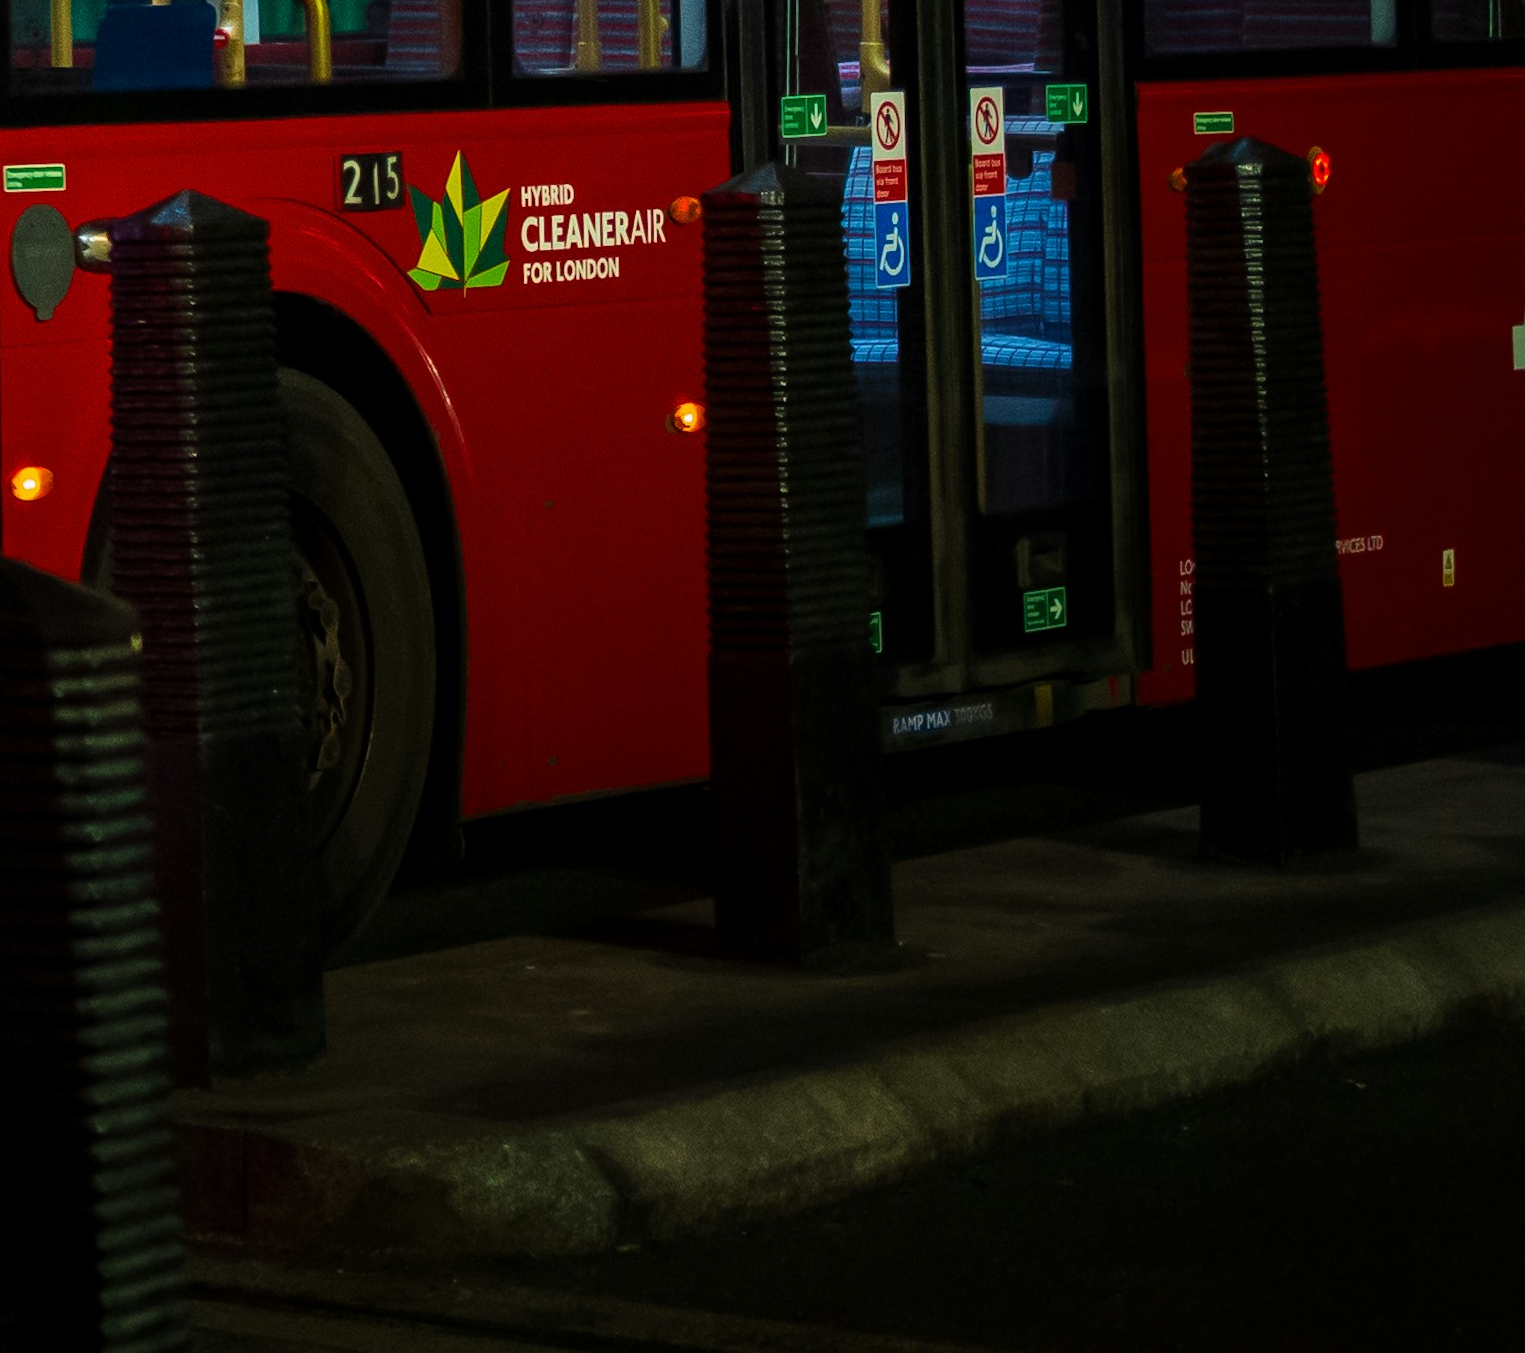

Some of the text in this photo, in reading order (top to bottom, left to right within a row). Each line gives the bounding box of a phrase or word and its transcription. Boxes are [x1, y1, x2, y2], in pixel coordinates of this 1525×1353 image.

[342, 156, 400, 206] 215
[521, 183, 574, 207] HYBRID
[523, 257, 620, 284] FOR LONDON
[1367, 535, 1384, 551] LTD
